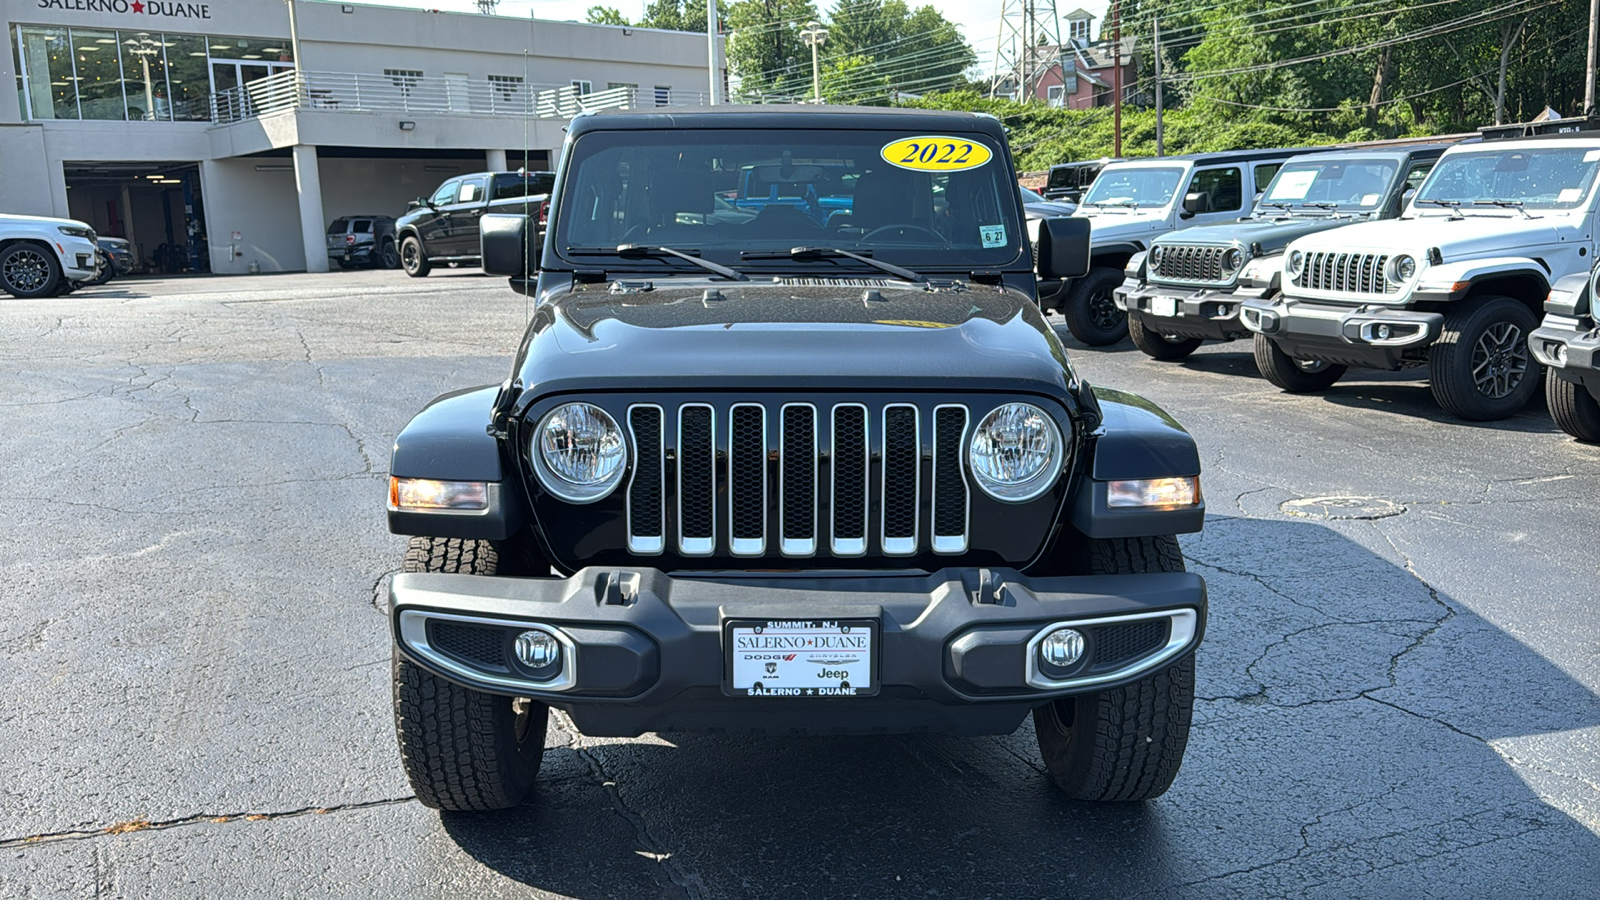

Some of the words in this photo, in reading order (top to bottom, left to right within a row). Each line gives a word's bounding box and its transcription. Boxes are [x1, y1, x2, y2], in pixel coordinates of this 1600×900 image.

[38, 0, 128, 13] SALERNO
[147, 1, 211, 19] DUANE
[899, 143, 972, 163] 2022
[985, 232, 991, 241] 6
[994, 231, 1003, 240] 27
[737, 636, 806, 649] SALERNO
[814, 636, 867, 648] DUANE
[817, 668, 849, 680] Jeep
[747, 688, 801, 696] SALERNO
